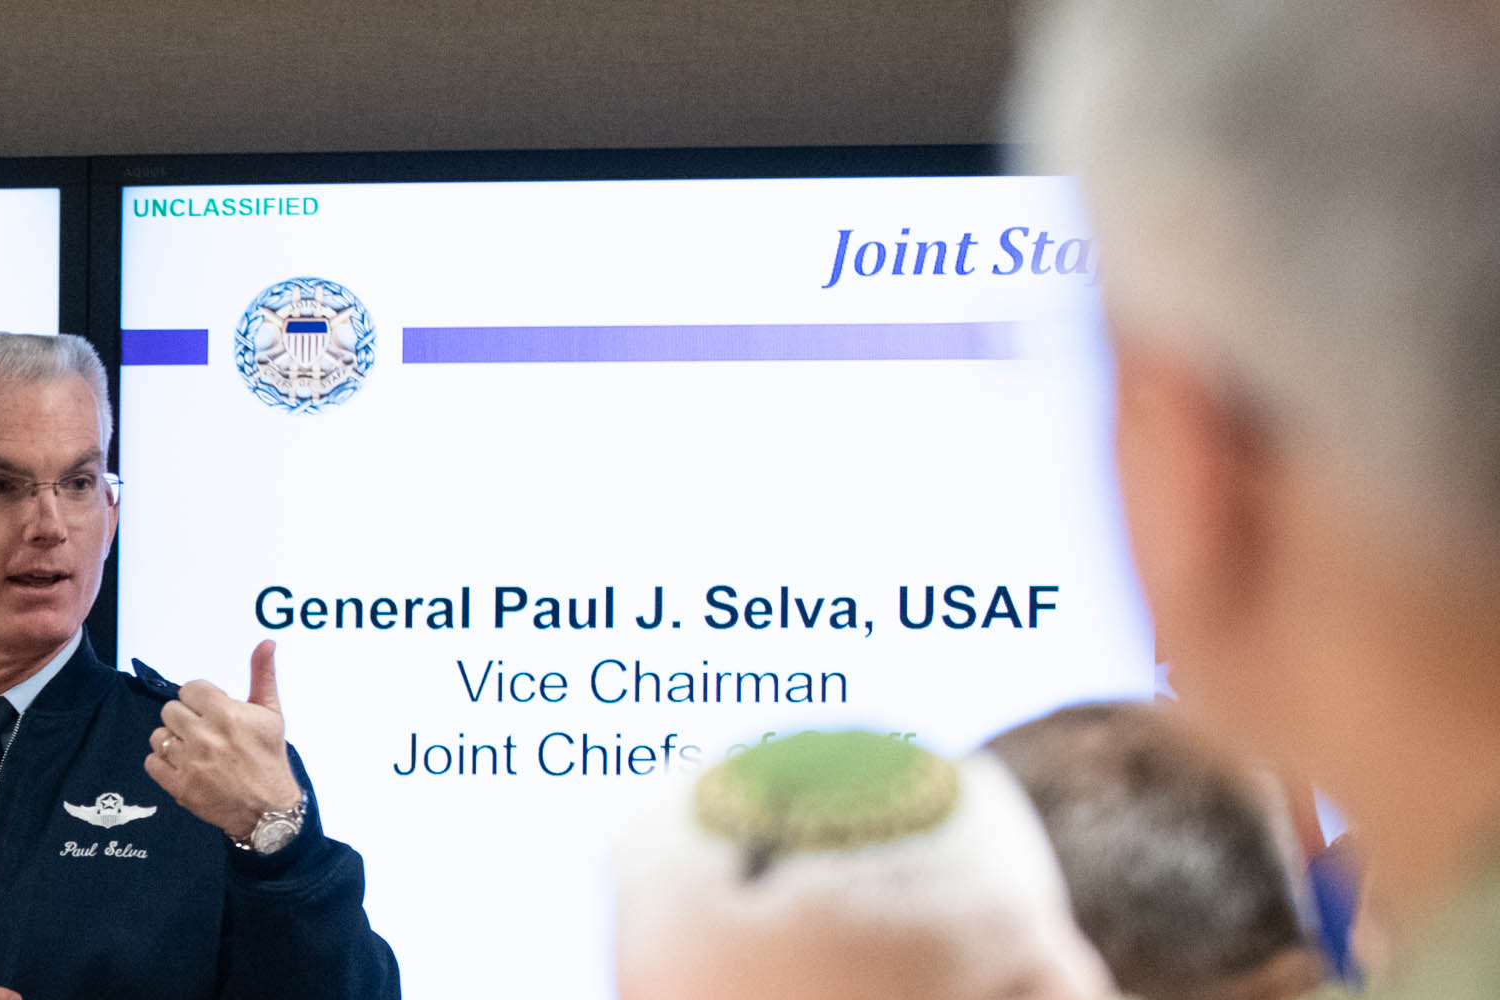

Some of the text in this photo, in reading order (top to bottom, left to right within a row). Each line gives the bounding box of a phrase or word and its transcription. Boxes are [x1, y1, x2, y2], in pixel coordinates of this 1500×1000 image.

[132, 196, 319, 218] UNCLASSIFIED
[821, 227, 979, 289] Joint
[254, 584, 1060, 639] General Paul J. Selva, USAF
[456, 658, 847, 704] Vice Chairman
[392, 732, 518, 776] Joint
[537, 731, 702, 776] Chiefs
[59, 840, 149, 859] Paul Selva
